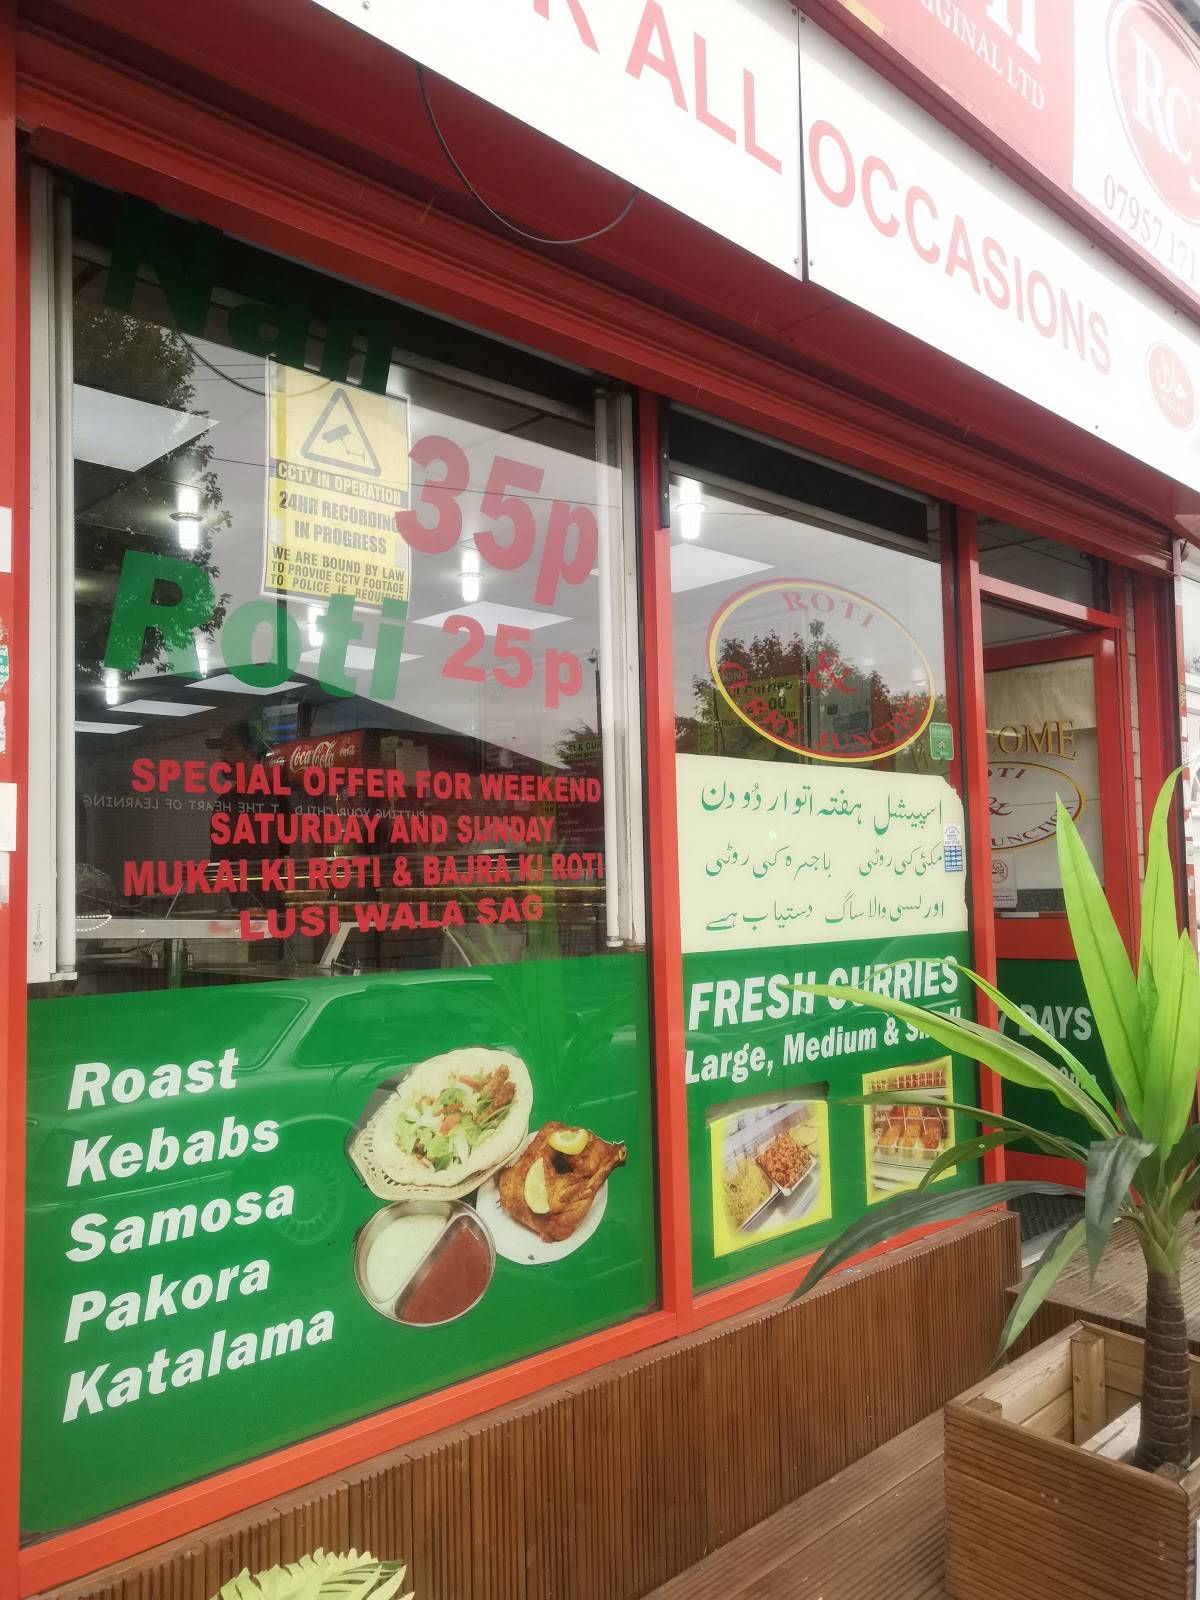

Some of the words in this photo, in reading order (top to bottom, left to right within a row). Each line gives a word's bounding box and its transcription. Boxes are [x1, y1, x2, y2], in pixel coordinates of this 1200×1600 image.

[1006, 56, 1046, 111] LTD
[625, 0, 782, 175] ALL
[808, 119, 1111, 376] OCCASIONS
[1103, 174, 1163, 250] 07957
[278, 463, 313, 484] CCTV
[317, 474, 331, 489] IN
[335, 477, 401, 505] OPERATION
[278, 491, 318, 515] 24HR
[294, 520, 309, 539] IN
[314, 525, 387, 554] PROGRESS
[397, 436, 598, 607] 35p
[271, 573, 284, 586] TO
[292, 577, 330, 594] POLICE
[337, 584, 348, 595] IF
[272, 546, 291, 561] WE
[295, 551, 318, 566] ARE
[322, 556, 361, 574] BOUND
[365, 562, 378, 576] BY
[382, 565, 406, 582] LAW
[272, 561, 285, 574] TO
[288, 564, 332, 582] PROVIDE
[335, 573, 361, 587] CCTV
[363, 577, 405, 594] FOOTAGE
[103, 549, 407, 699] Roti
[440, 615, 582, 709] 25p
[779, 590, 878, 630] ROTI
[807, 649, 858, 694] &
[131, 758, 294, 795] SPECIAL
[303, 764, 406, 799] OFFER
[415, 770, 473, 801] FOR
[480, 773, 602, 803] WEEKEND
[210, 812, 380, 845] SATURDAY
[390, 814, 448, 844] AND
[457, 815, 556, 844] SUNDAY
[124, 859, 248, 897] MUKAI
[261, 857, 296, 893] KI
[308, 856, 381, 891] ROTI
[391, 855, 413, 888] &
[423, 854, 511, 887] BAJRA
[518, 854, 543, 882] KI
[551, 852, 605, 882] ROTI
[239, 906, 340, 943] LUSI
[354, 901, 466, 934] WALA
[476, 894, 544, 925] SAG
[688, 970, 816, 1031] FRESH
[828, 955, 959, 1010] CURRIES
[1018, 1004, 1092, 1041] DAYS
[684, 1042, 774, 1085] Large,
[783, 1024, 877, 1066] Medium
[884, 1016, 900, 1047] &
[67, 1048, 239, 1111] Roast
[66, 1116, 280, 1187] Kebabs
[65, 1184, 295, 1262] Samosa
[64, 1258, 270, 1344] Pakora
[62, 1310, 335, 1423] Katalama
